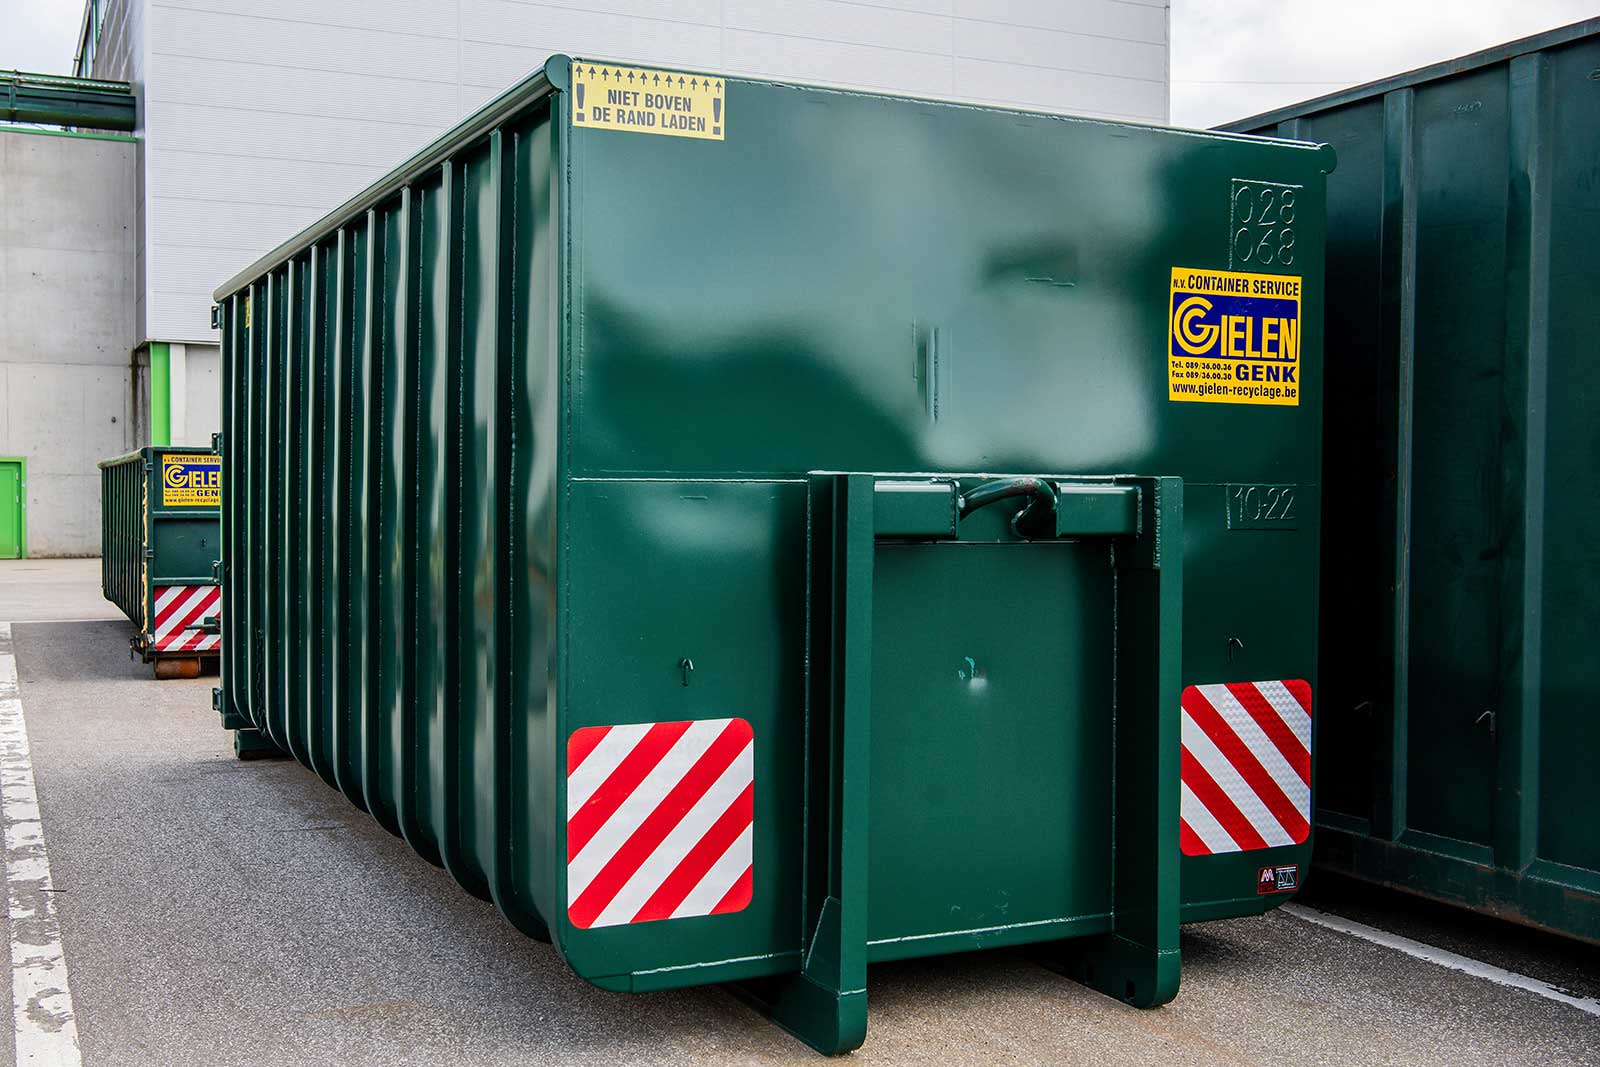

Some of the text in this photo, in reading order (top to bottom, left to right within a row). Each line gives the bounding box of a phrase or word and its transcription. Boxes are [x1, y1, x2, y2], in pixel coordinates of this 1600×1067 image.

[607, 89, 692, 112] NIET BOVEN
[592, 106, 706, 132] DE RAND LADEN
[1234, 186, 1295, 226] 028
[1234, 228, 1295, 265] 068
[1173, 274, 1299, 296] N.V. CONTAINER SERVICE
[1173, 296, 1297, 360] GIELEN
[1171, 361, 1184, 369] Tel.
[1171, 370, 1184, 378] Fax
[1235, 363, 1297, 383] GENK
[1172, 382, 1297, 400] www.gielen-recyclage.be
[196, 489, 220, 497] GEN
[1234, 486, 1297, 521] 10-22
